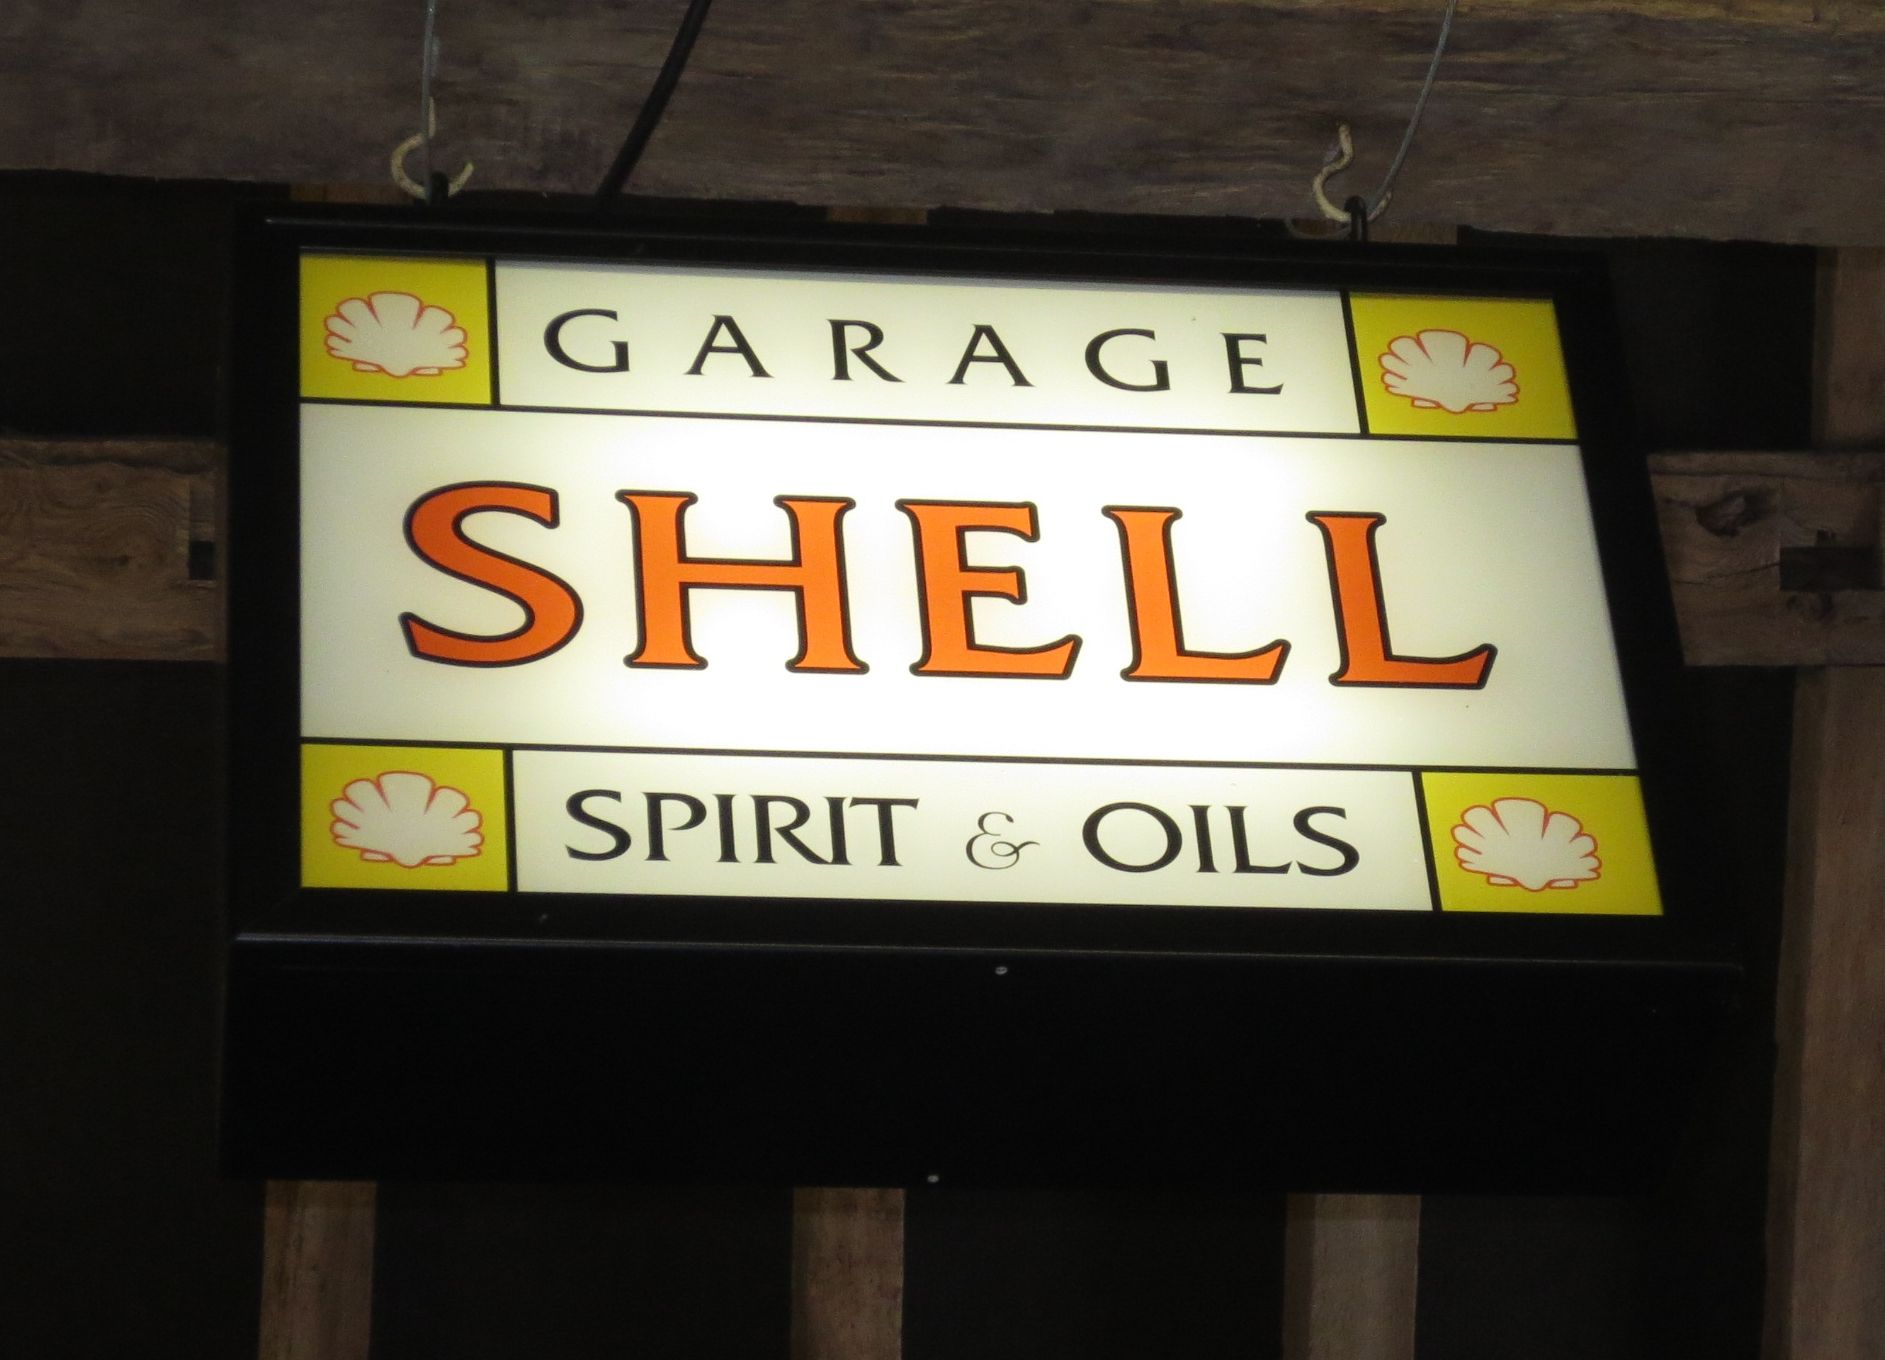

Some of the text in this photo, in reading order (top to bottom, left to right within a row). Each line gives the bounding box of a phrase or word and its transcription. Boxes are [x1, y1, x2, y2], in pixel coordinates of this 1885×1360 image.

[543, 308, 1284, 395] GARAGE
[397, 480, 1499, 691] SHELL
[565, 789, 1360, 877] SPIRIT & OILS
